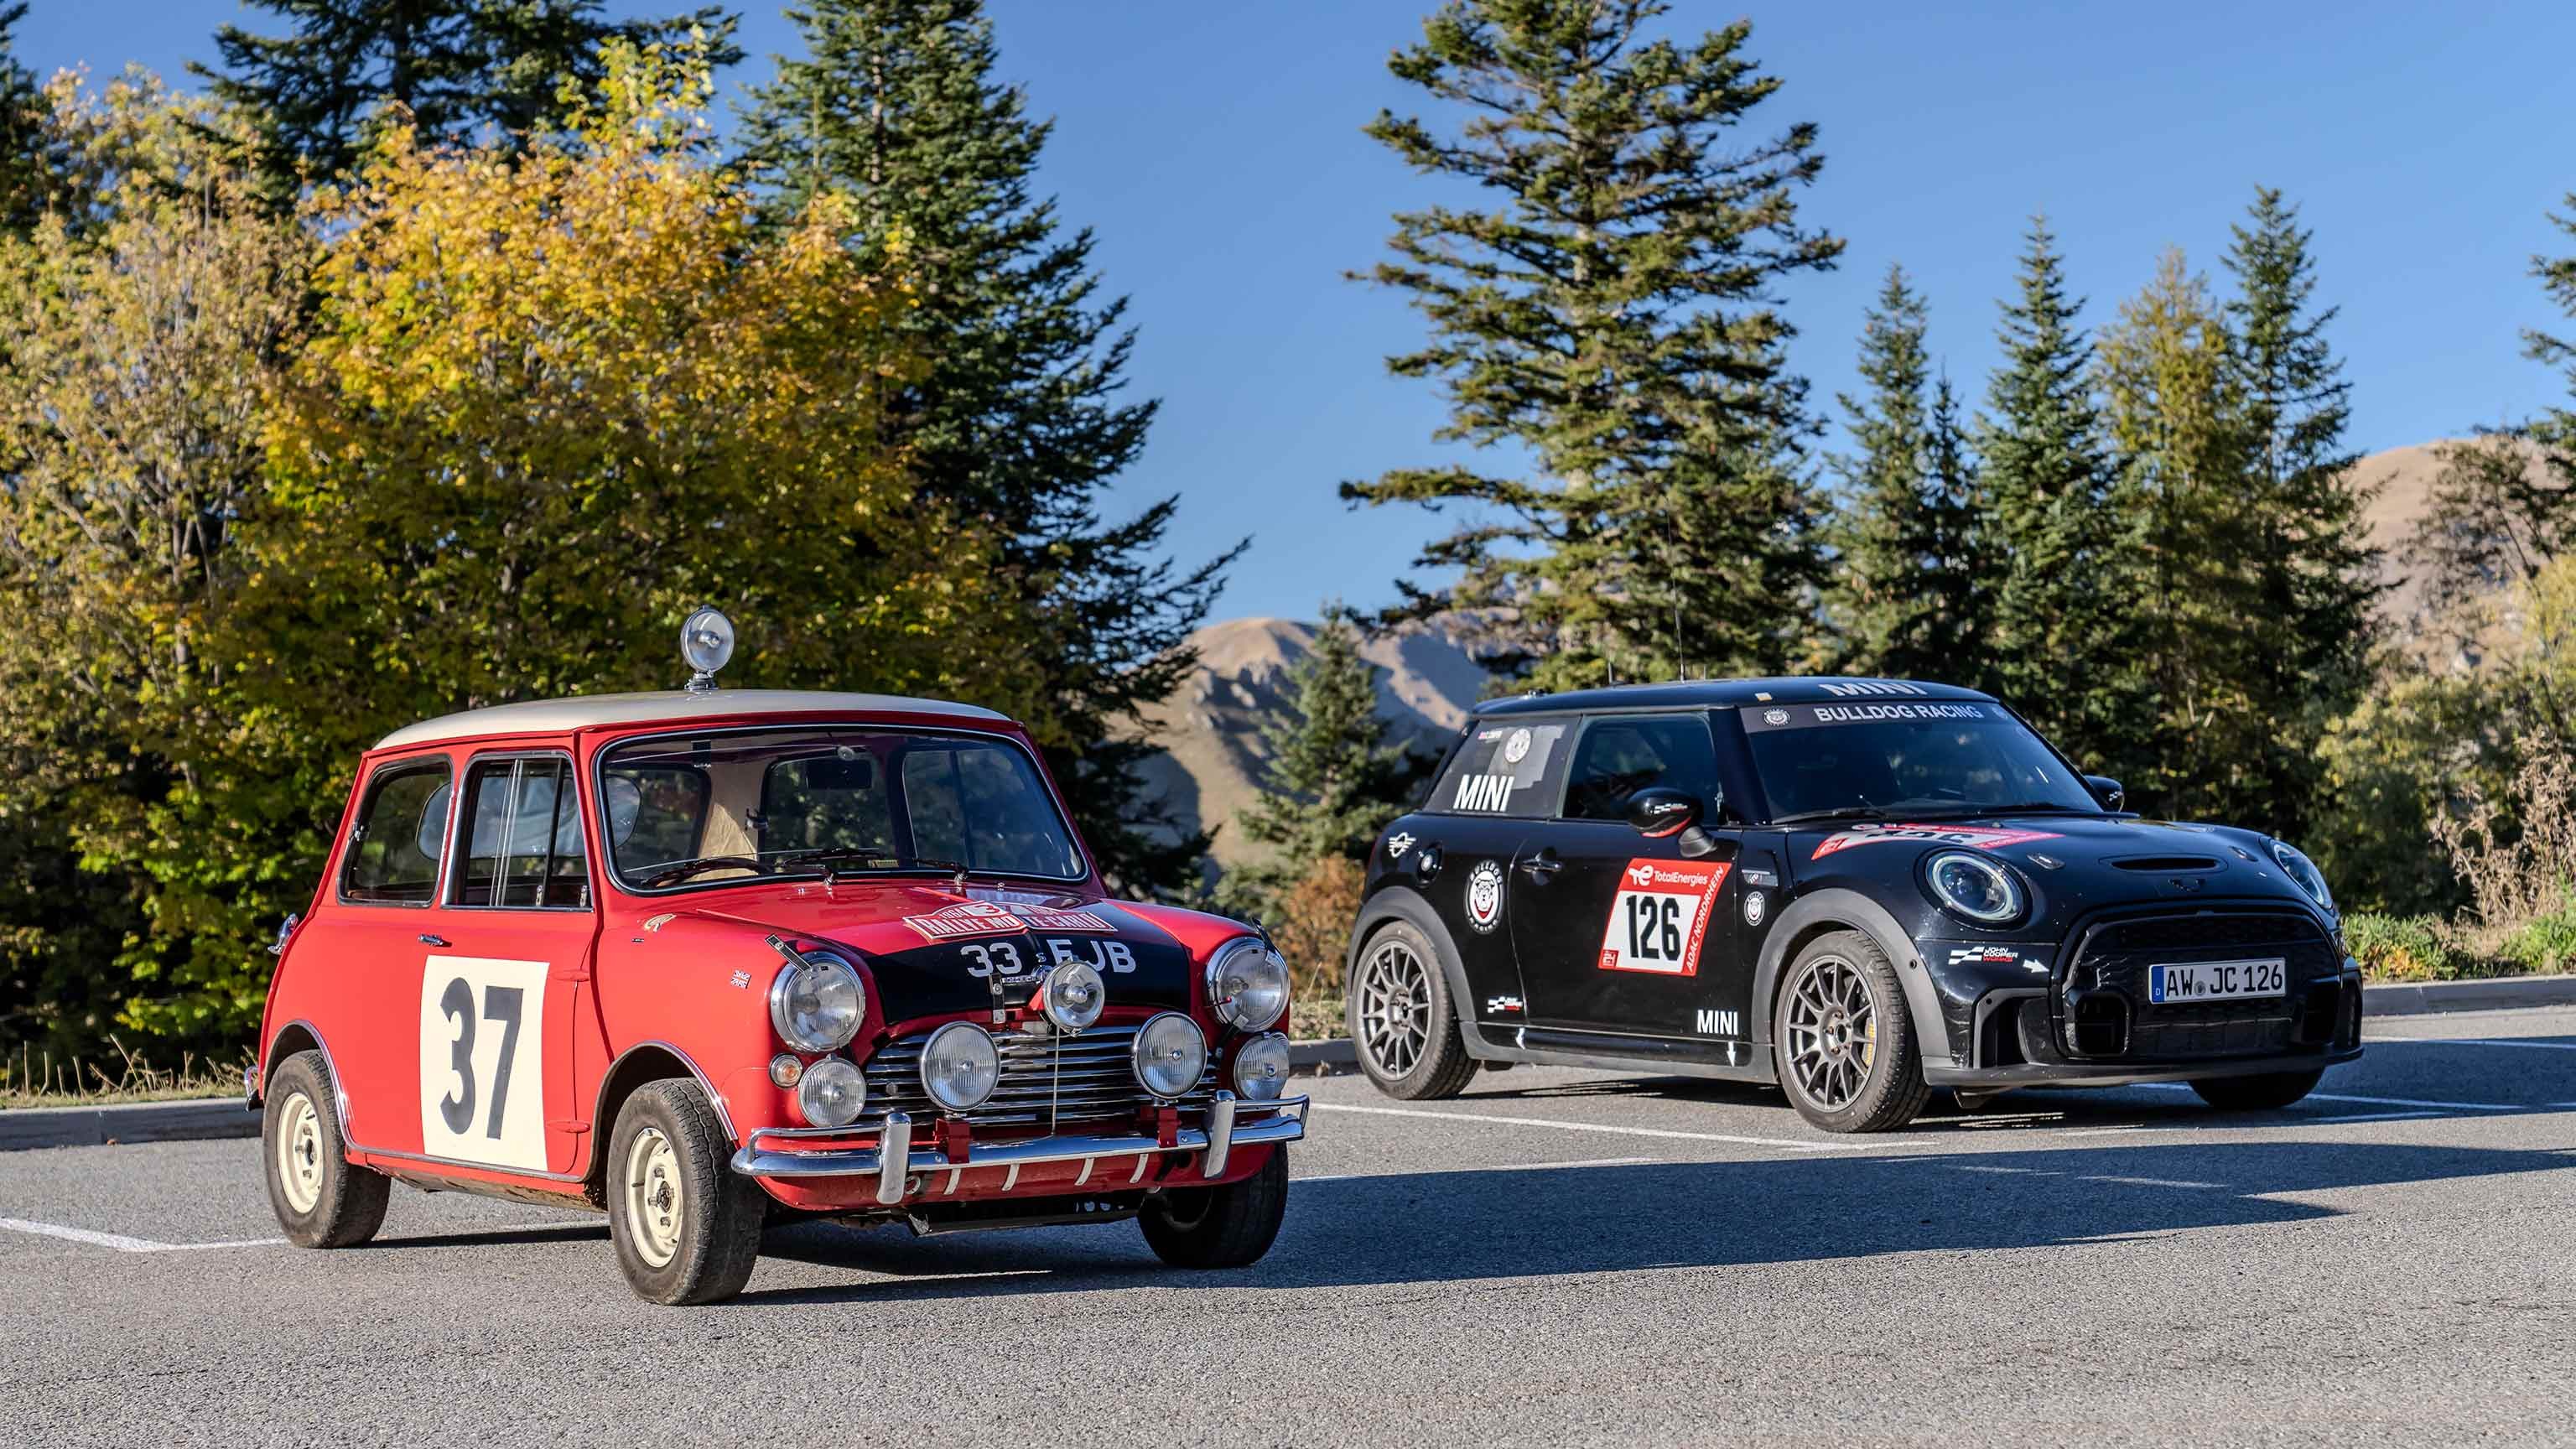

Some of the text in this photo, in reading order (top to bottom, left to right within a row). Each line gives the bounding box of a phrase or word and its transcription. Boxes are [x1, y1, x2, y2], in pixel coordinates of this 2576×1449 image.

[1818, 683, 1928, 696] MINI
[1814, 704, 1984, 722] BULLDOG RACING
[1453, 774, 1514, 812] MINI
[1654, 870, 1708, 887] TotalEnergies
[917, 917, 991, 935] RALLYE
[1626, 895, 1681, 961] 126
[1685, 865, 1725, 972] ADAC NORDRHEIN
[960, 943, 1023, 978] 33
[2167, 969, 2194, 997] AW
[2210, 967, 2238, 994] JC
[2244, 964, 2283, 993] 126
[1697, 1010, 1738, 1036] MINI
[440, 977, 524, 1140] 37
